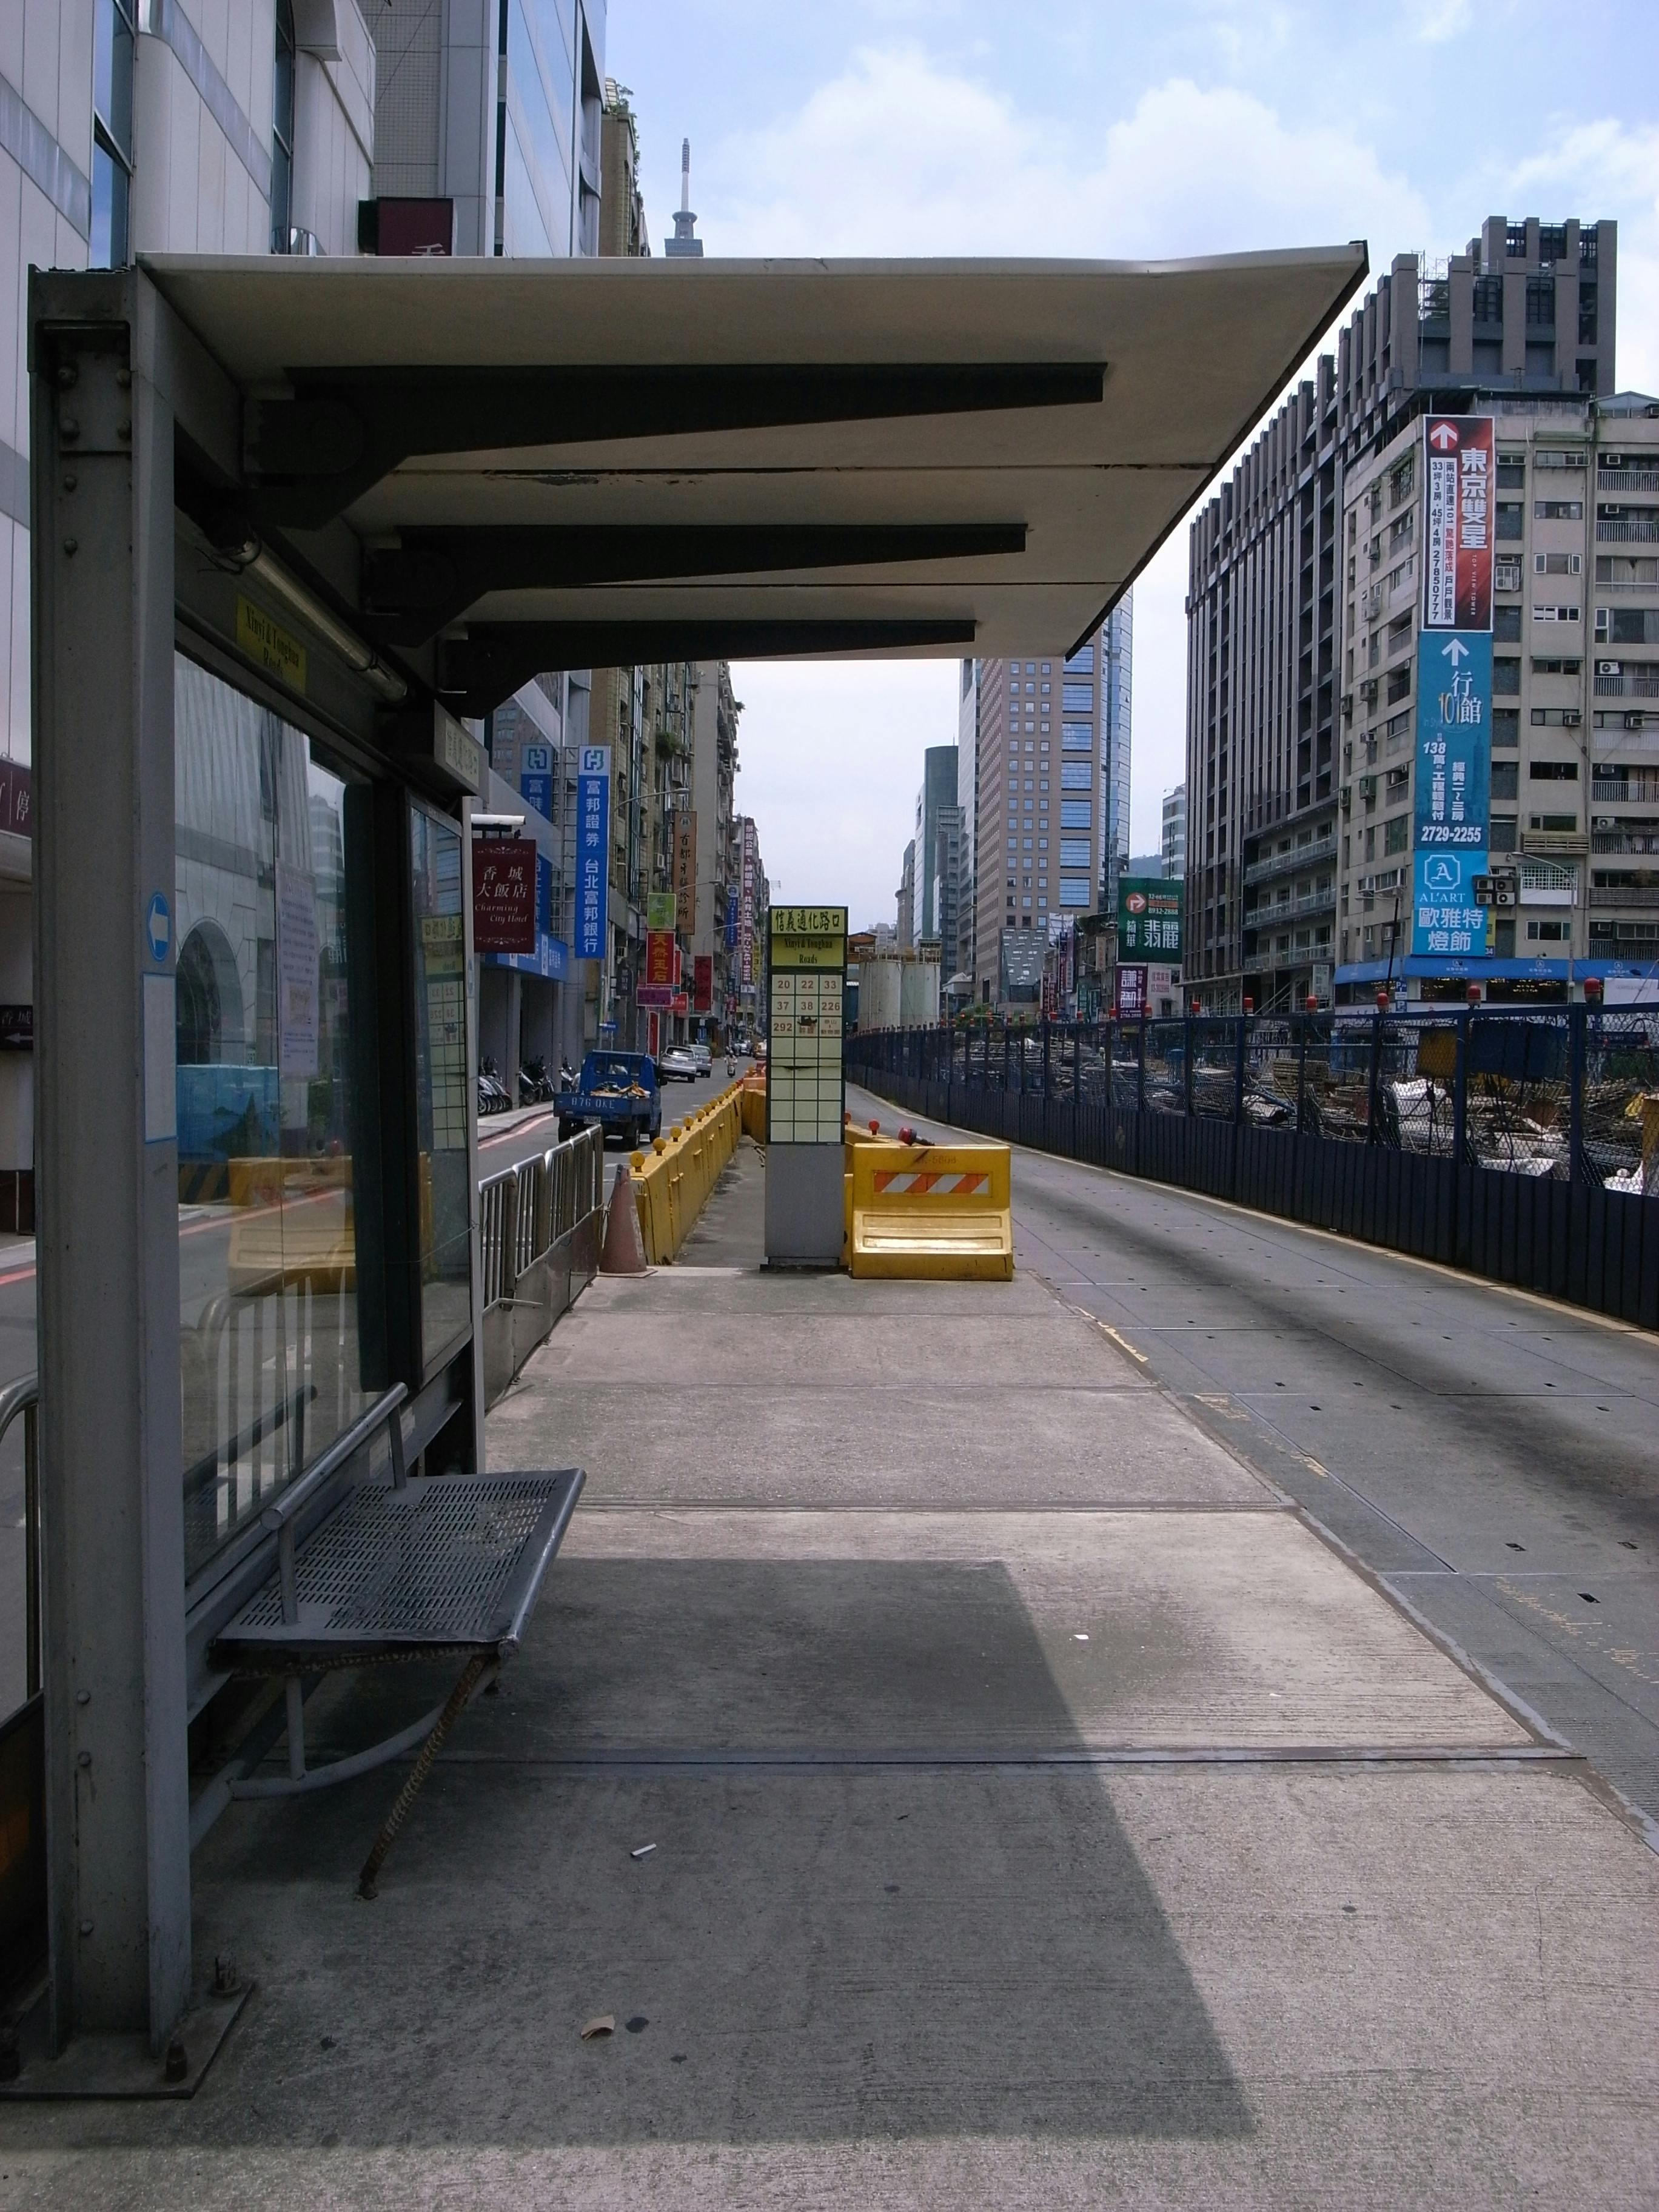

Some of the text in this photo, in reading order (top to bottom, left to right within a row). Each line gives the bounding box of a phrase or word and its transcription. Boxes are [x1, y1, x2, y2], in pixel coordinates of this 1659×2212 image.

[1460, 447, 1488, 549] 東京雙星
[1432, 550, 1440, 620] 27850777
[1421, 825, 1482, 843] 2729-2255
[583, 780, 601, 953] 富邦證券 台北富邦銀行
[476, 882, 528, 899] 大飯店
[475, 903, 518, 914] Charming
[490, 914, 529, 925] City Hotel
[776, 910, 840, 931] 信義通化路口
[1418, 907, 1484, 930] 歐雅特
[1144, 919, 1179, 949] 翡麗
[1427, 931, 1472, 952] 燈飾
[652, 934, 668, 982] 天然玉石
[799, 954, 817, 964] Roads
[777, 980, 837, 989] 20 22 33
[777, 1001, 840, 1011] 37 38 226
[773, 1023, 793, 1031] 292
